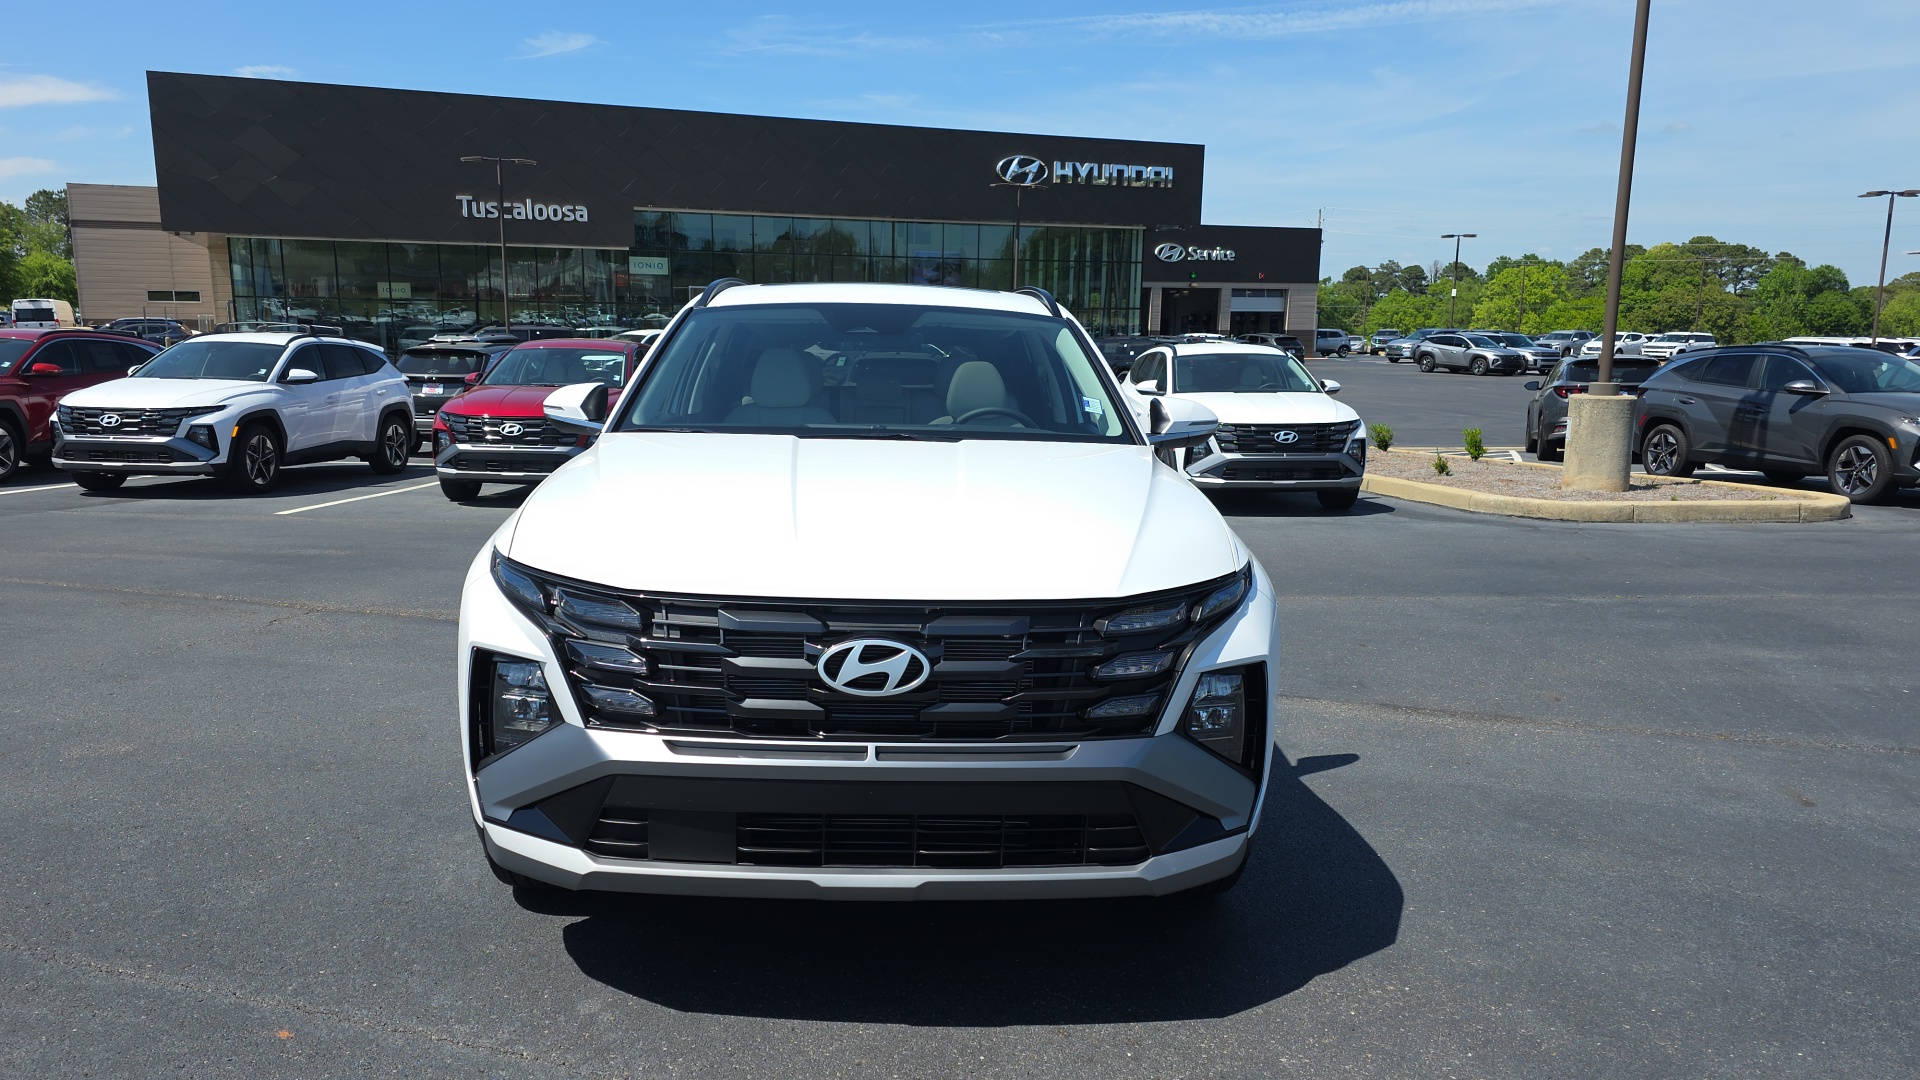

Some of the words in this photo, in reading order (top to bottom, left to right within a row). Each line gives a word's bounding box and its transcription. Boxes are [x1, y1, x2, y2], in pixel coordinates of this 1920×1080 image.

[1053, 161, 1173, 188] HYUNDAI
[1187, 246, 1235, 261] Service
[633, 262, 664, 270] IONIQ
